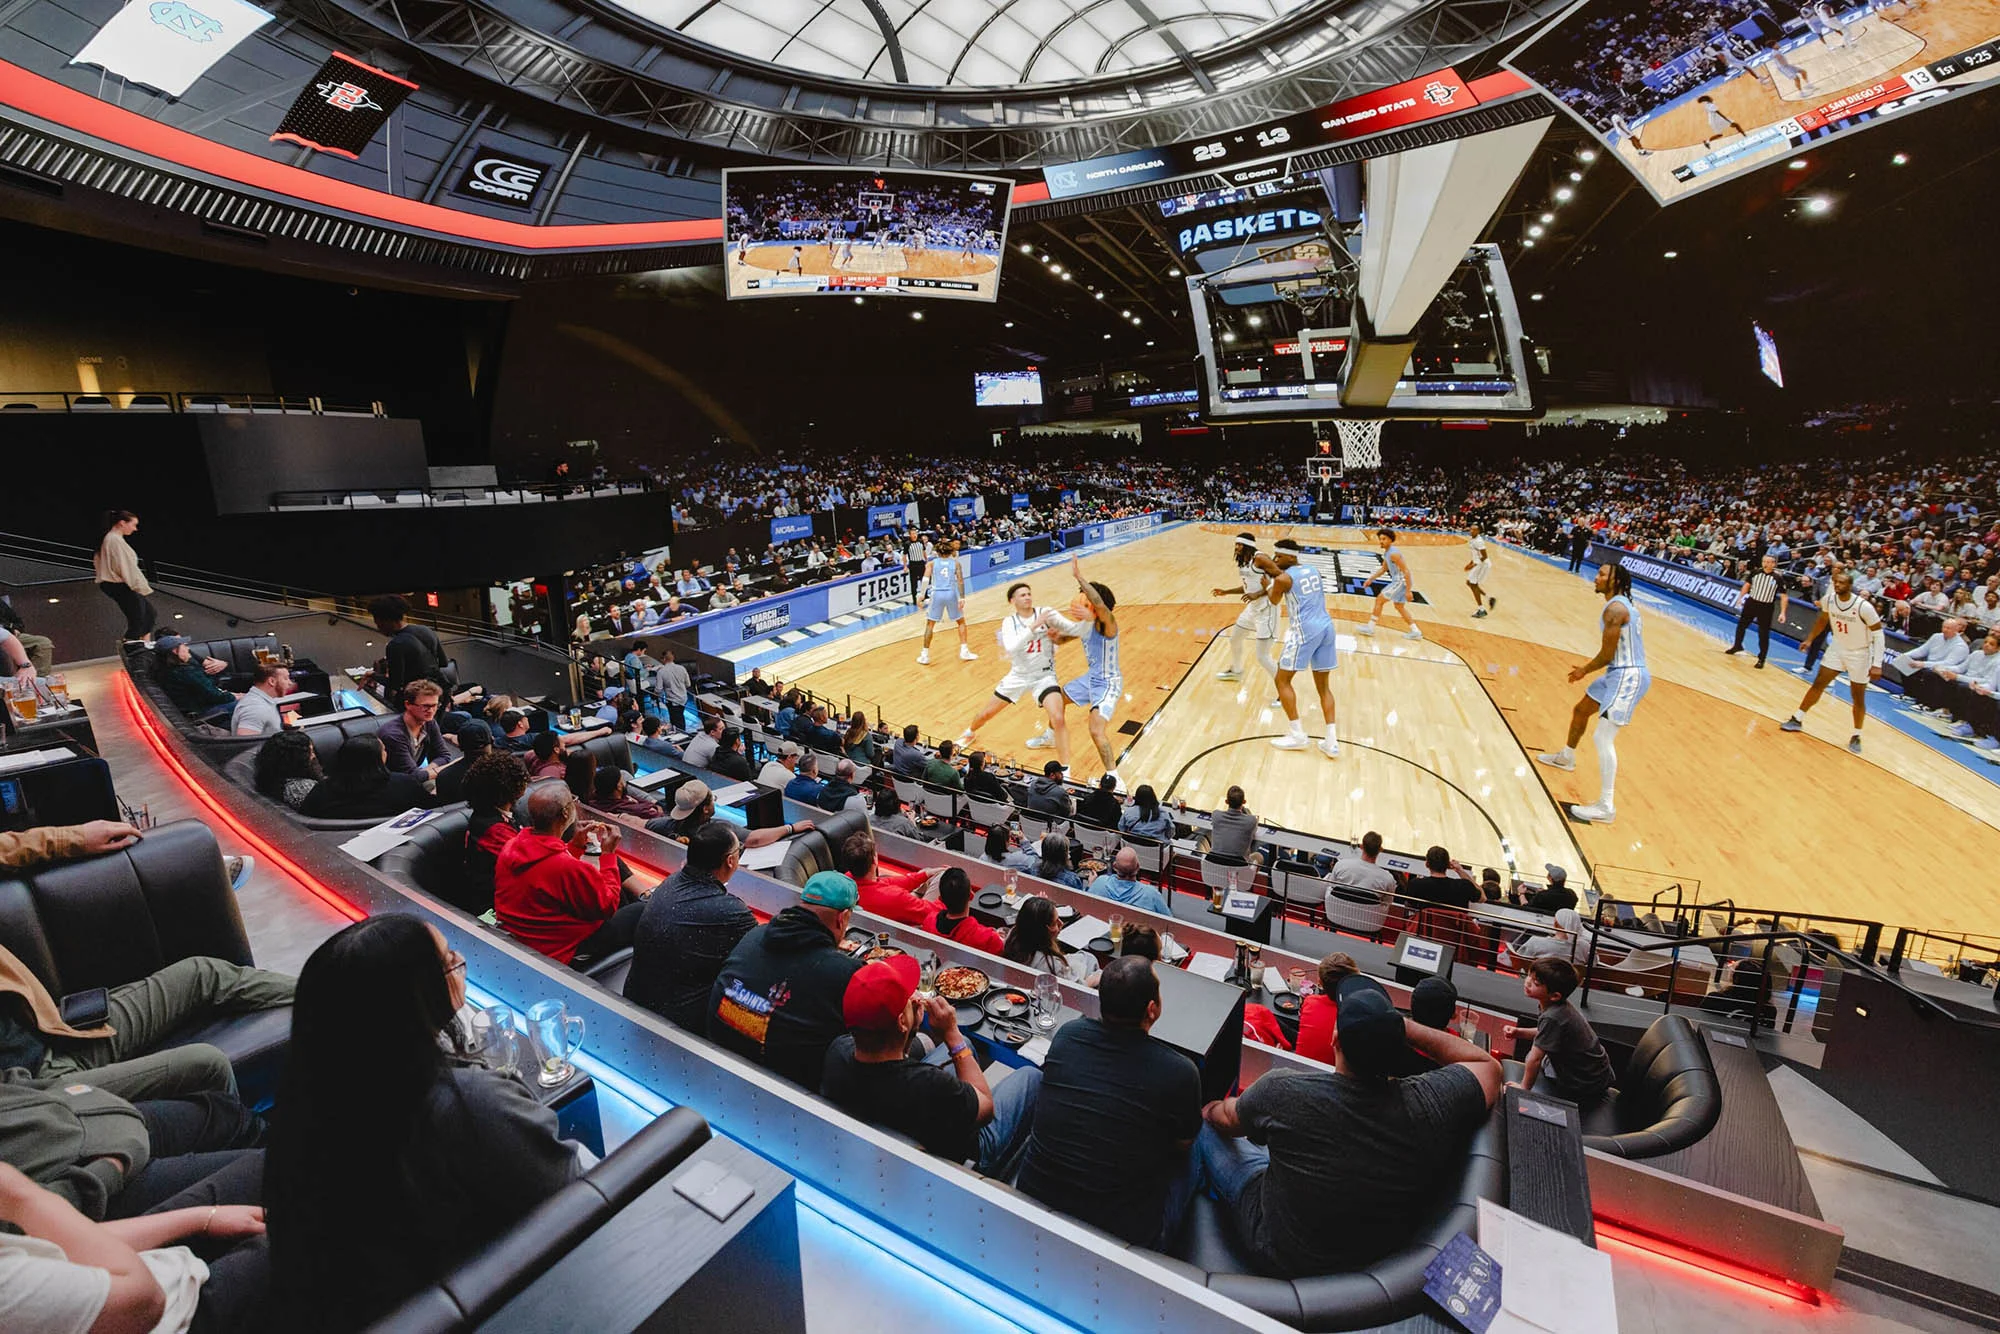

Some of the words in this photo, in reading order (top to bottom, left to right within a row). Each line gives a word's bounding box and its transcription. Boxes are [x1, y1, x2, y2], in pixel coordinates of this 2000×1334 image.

[1935, 65, 1956, 77] 1ST
[1964, 50, 1993, 67] 9:25
[1908, 71, 1931, 87] 13
[1828, 98, 1847, 111] SAN
[1846, 88, 1874, 104] DIEGO
[1873, 84, 1885, 95] ST
[1321, 116, 1346, 129] SAN
[1345, 108, 1377, 124] DIEGO
[1377, 97, 1417, 115] STATE
[1256, 126, 1291, 148] 13
[1780, 121, 1800, 136] 25
[1193, 142, 1227, 163] 25
[1086, 168, 1118, 180] NORTH
[1118, 159, 1165, 178] CAROLINA
[940, 566, 949, 579] 4
[1619, 555, 1665, 581] CELEBRATES
[857, 572, 910, 606] FIRST
[1299, 575, 1322, 595] 22
[751, 608, 777, 626] MARCH
[755, 614, 790, 635] MADNESS
[1836, 621, 1848, 634] 31
[1026, 638, 1042, 654] 21
